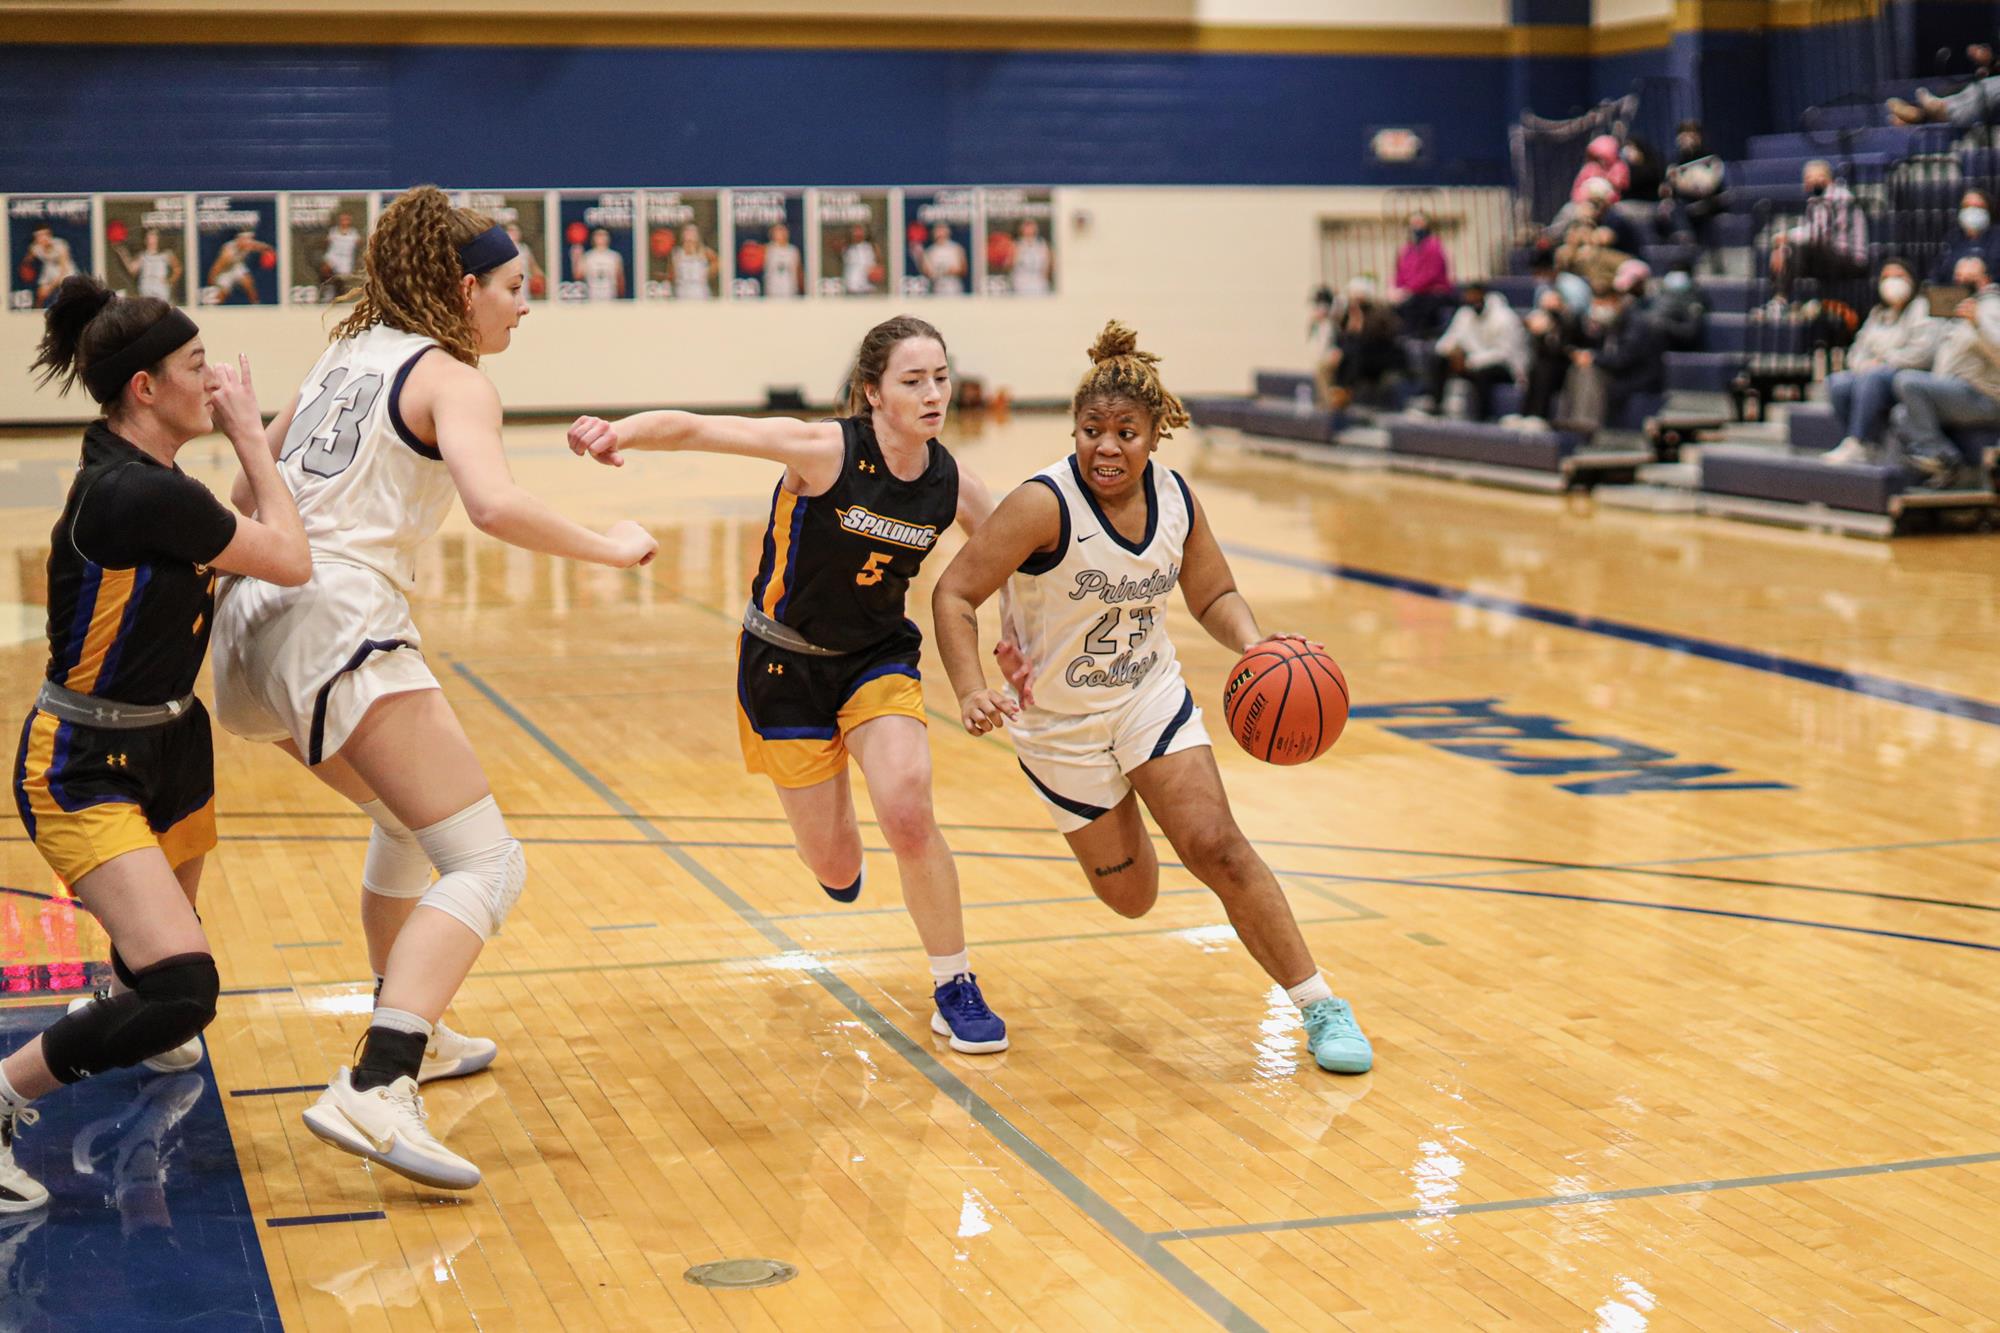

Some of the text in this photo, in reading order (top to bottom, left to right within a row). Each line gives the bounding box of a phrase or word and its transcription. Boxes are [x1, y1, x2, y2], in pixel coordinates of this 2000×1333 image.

[279, 366, 384, 479] 13
[842, 507, 937, 548] SPALDING
[856, 551, 893, 586] 5
[1084, 606, 1156, 654] 23
